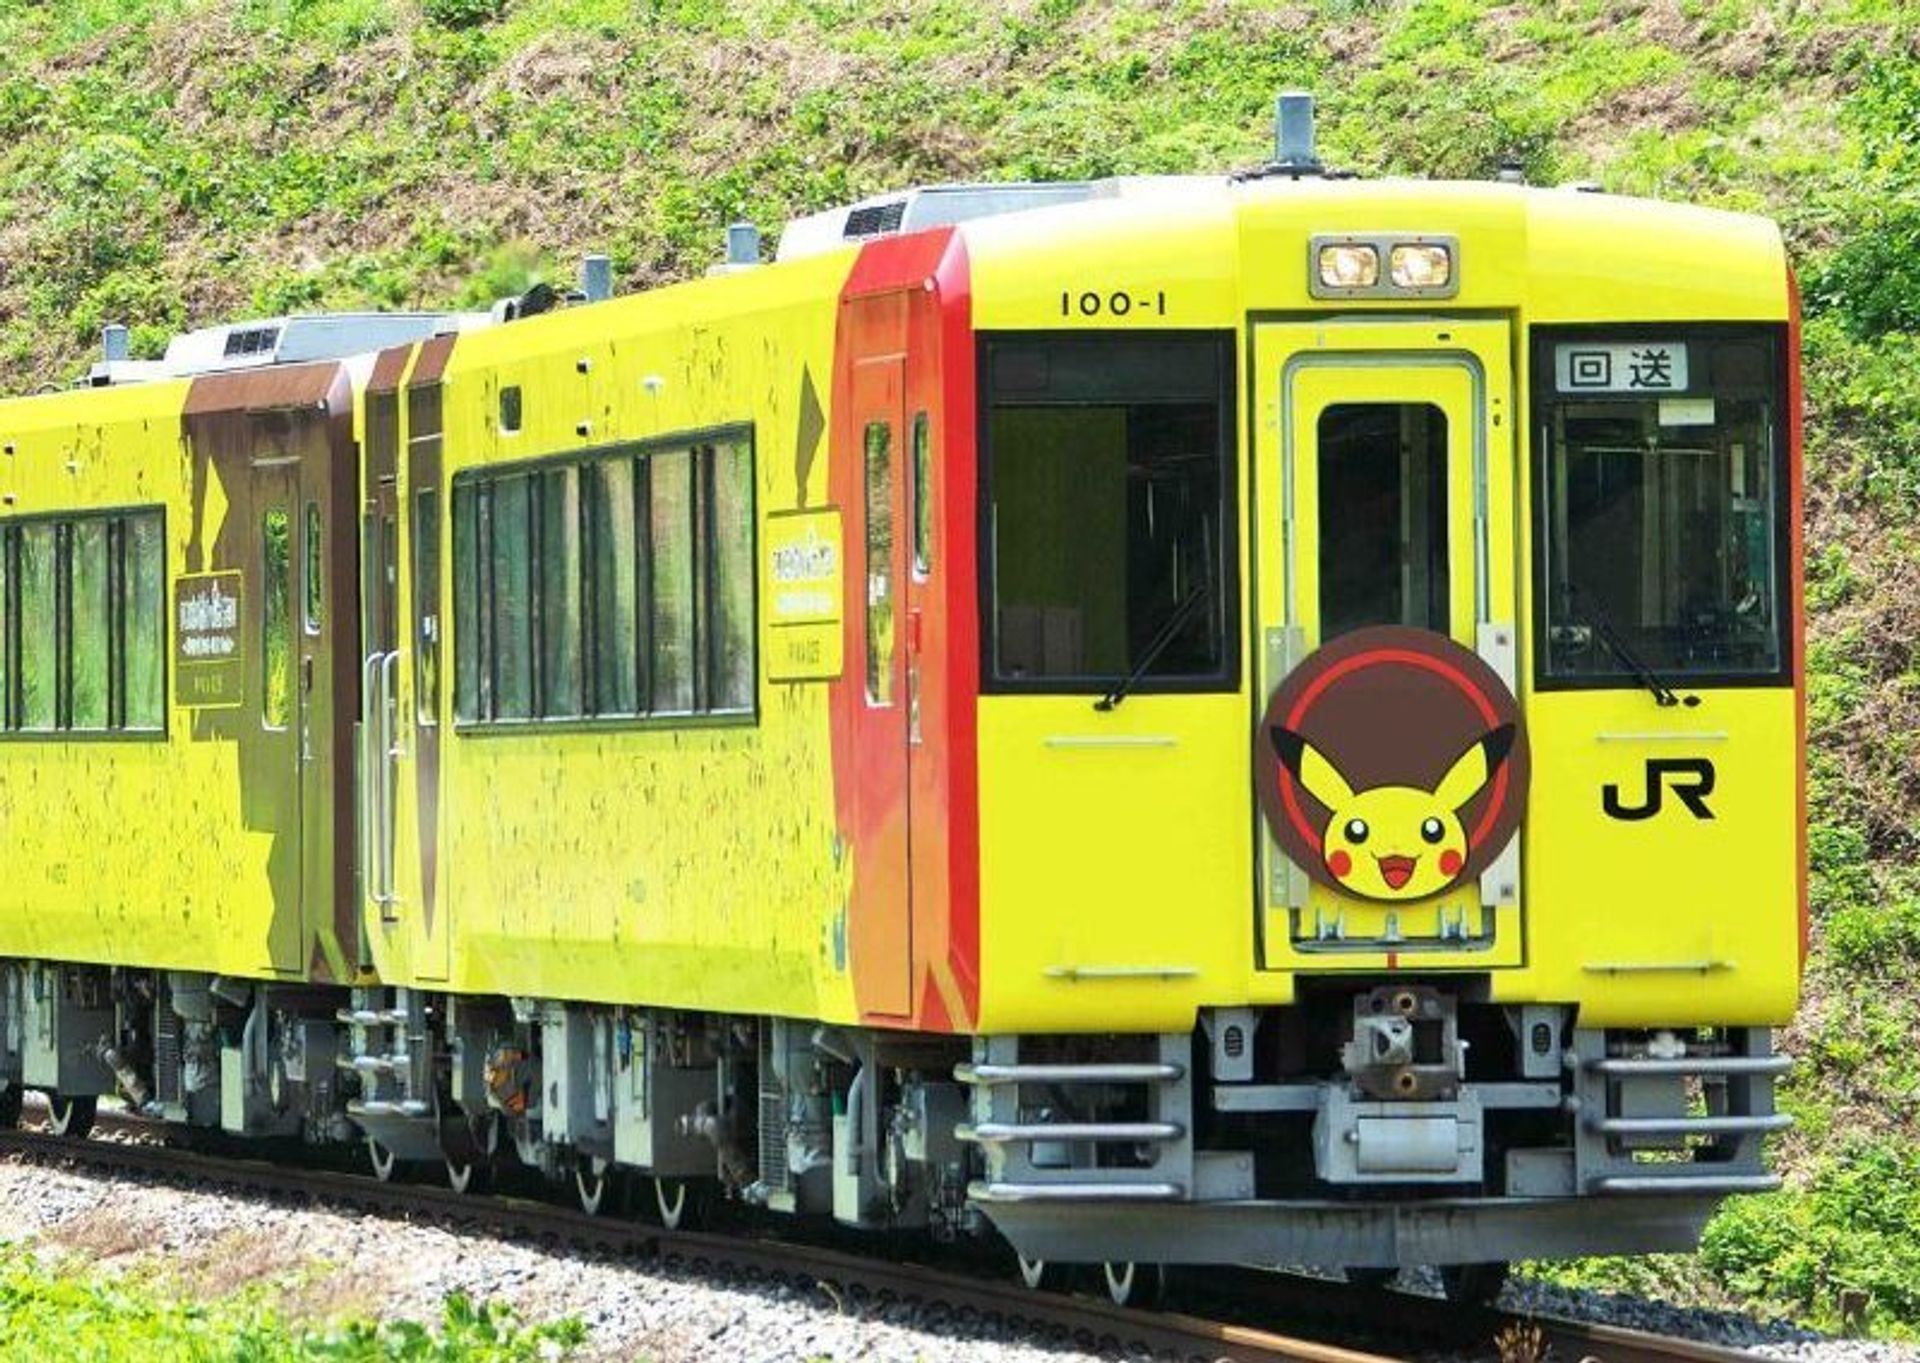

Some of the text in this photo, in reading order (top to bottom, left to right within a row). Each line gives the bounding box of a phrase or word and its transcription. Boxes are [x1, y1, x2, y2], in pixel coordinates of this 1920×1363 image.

[1062, 292, 1165, 316] 100-1
[1570, 349, 1671, 387] 回送
[1602, 758, 1716, 820] JR
